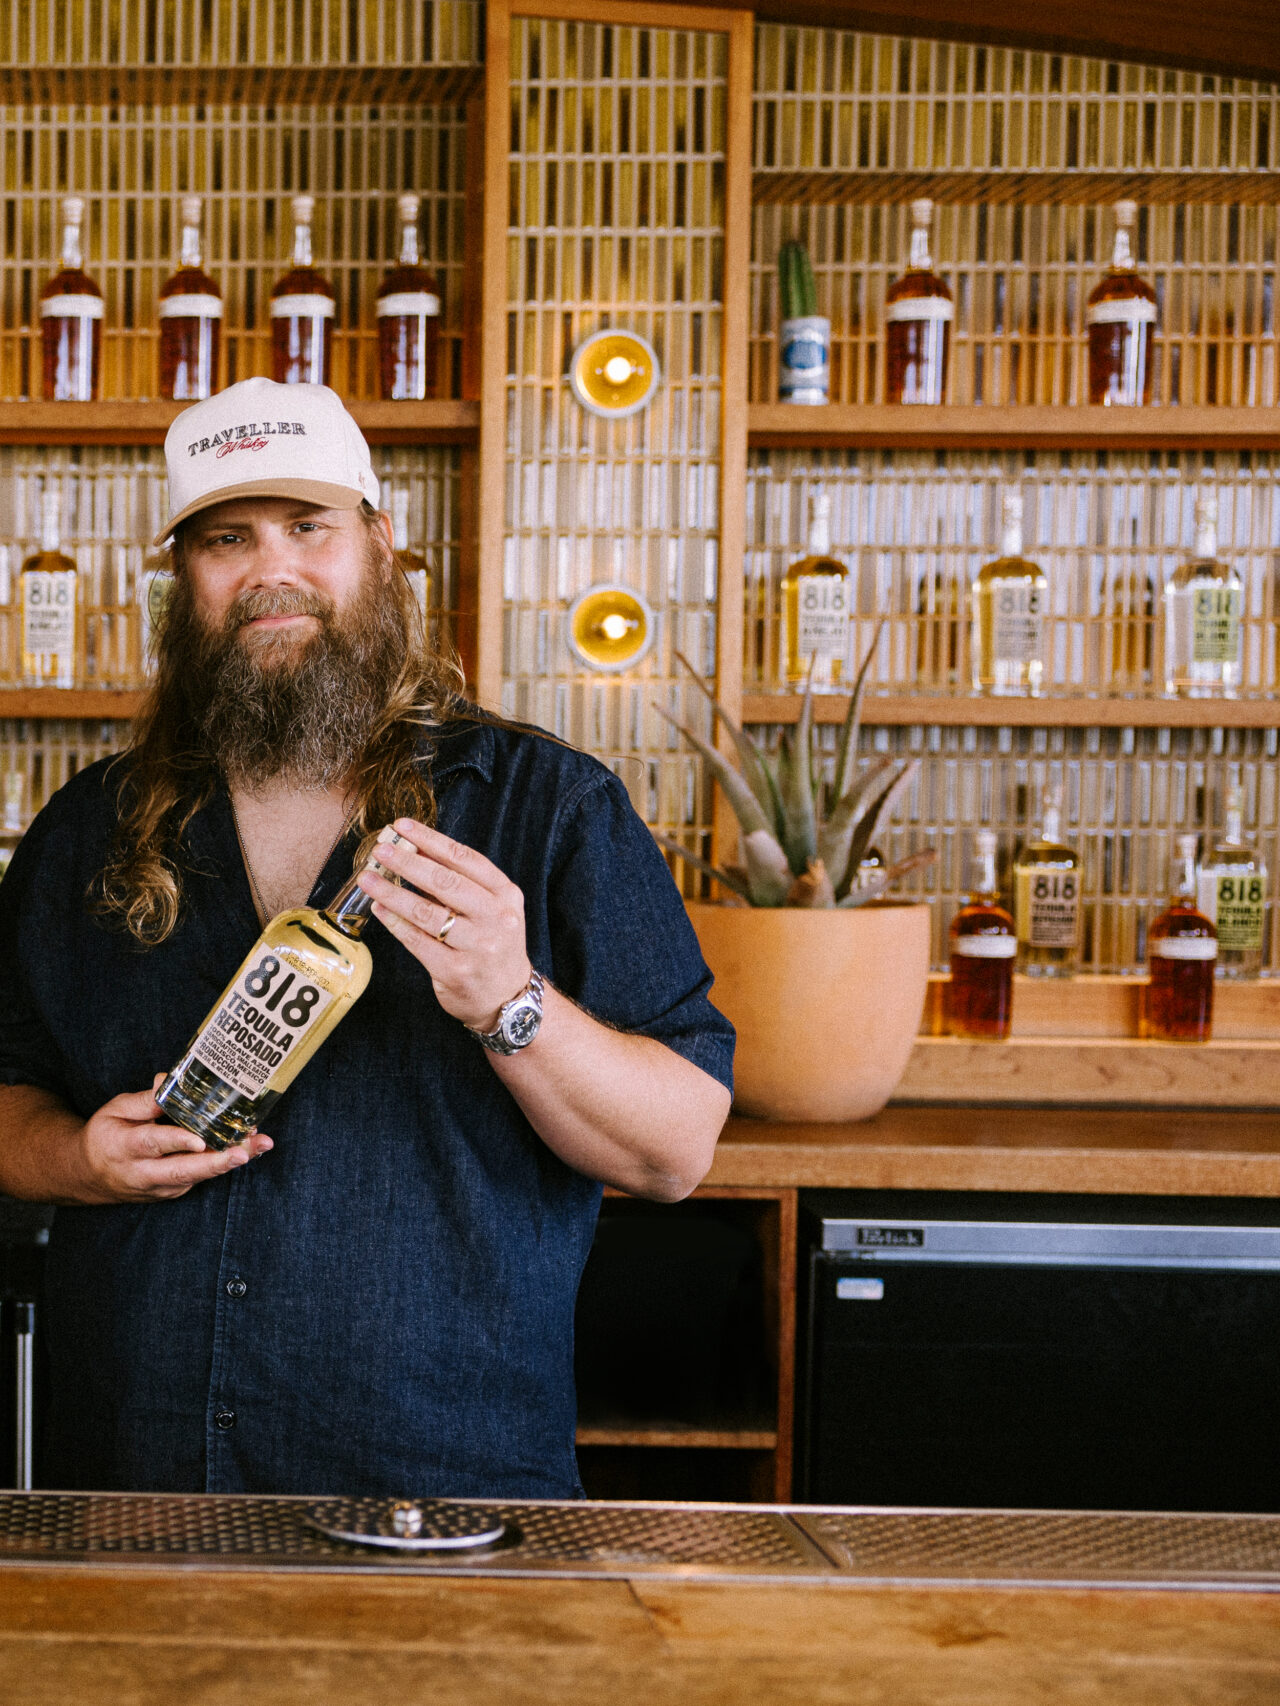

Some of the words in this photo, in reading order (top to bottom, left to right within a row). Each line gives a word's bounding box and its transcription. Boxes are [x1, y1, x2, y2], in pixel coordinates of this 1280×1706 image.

[188, 421, 307, 457] TRAVELLER
[29, 580, 70, 606] 818
[804, 584, 845, 611] 818
[1034, 874, 1076, 900] 818
[1219, 877, 1261, 903] 818
[244, 955, 320, 1028] 818
[226, 991, 294, 1053] TEQUILA
[213, 1008, 283, 1068] REPOSADO
[225, 1038, 251, 1060] AGAVE
[250, 1055, 272, 1075] AZUL
[236, 1062, 265, 1085] MEXICO
